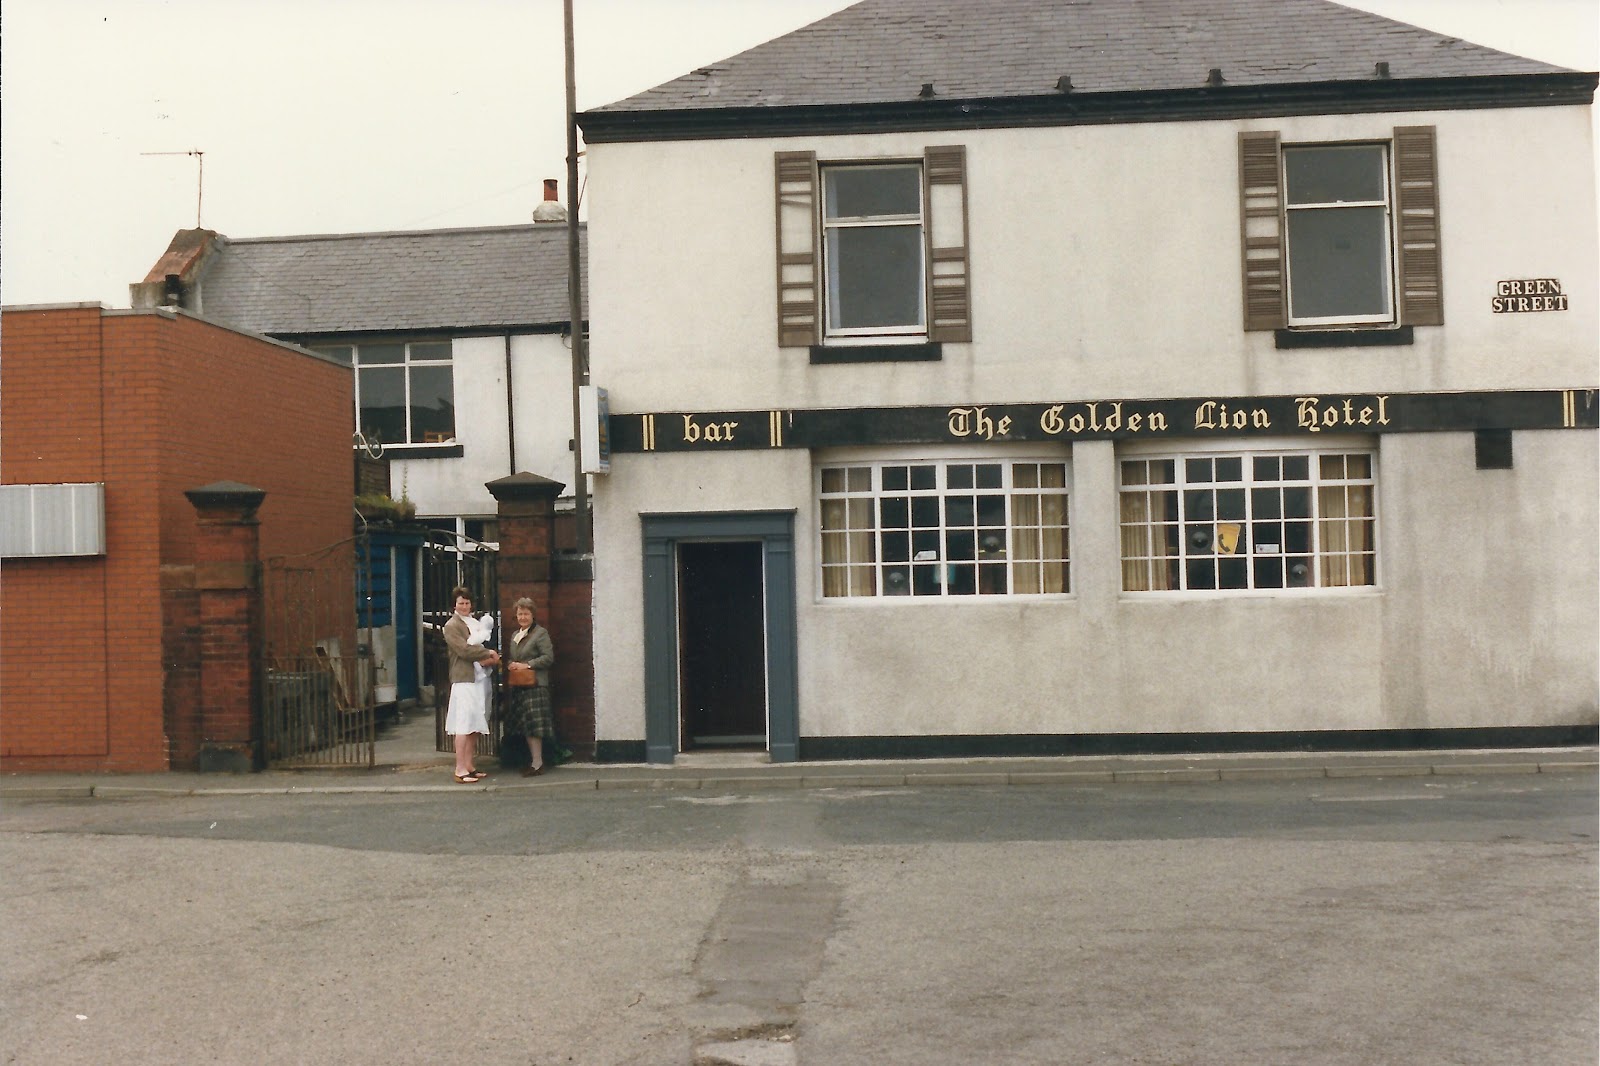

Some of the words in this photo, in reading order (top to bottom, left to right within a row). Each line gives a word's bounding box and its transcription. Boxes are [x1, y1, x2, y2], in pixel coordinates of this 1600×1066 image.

[1498, 280, 1560, 296] GREEN
[1492, 295, 1567, 312] STREET
[682, 413, 739, 443] bar
[947, 407, 1012, 440] The
[1040, 402, 1168, 434] Golden
[1194, 400, 1271, 430] Lion
[1294, 395, 1390, 432] Hotel
